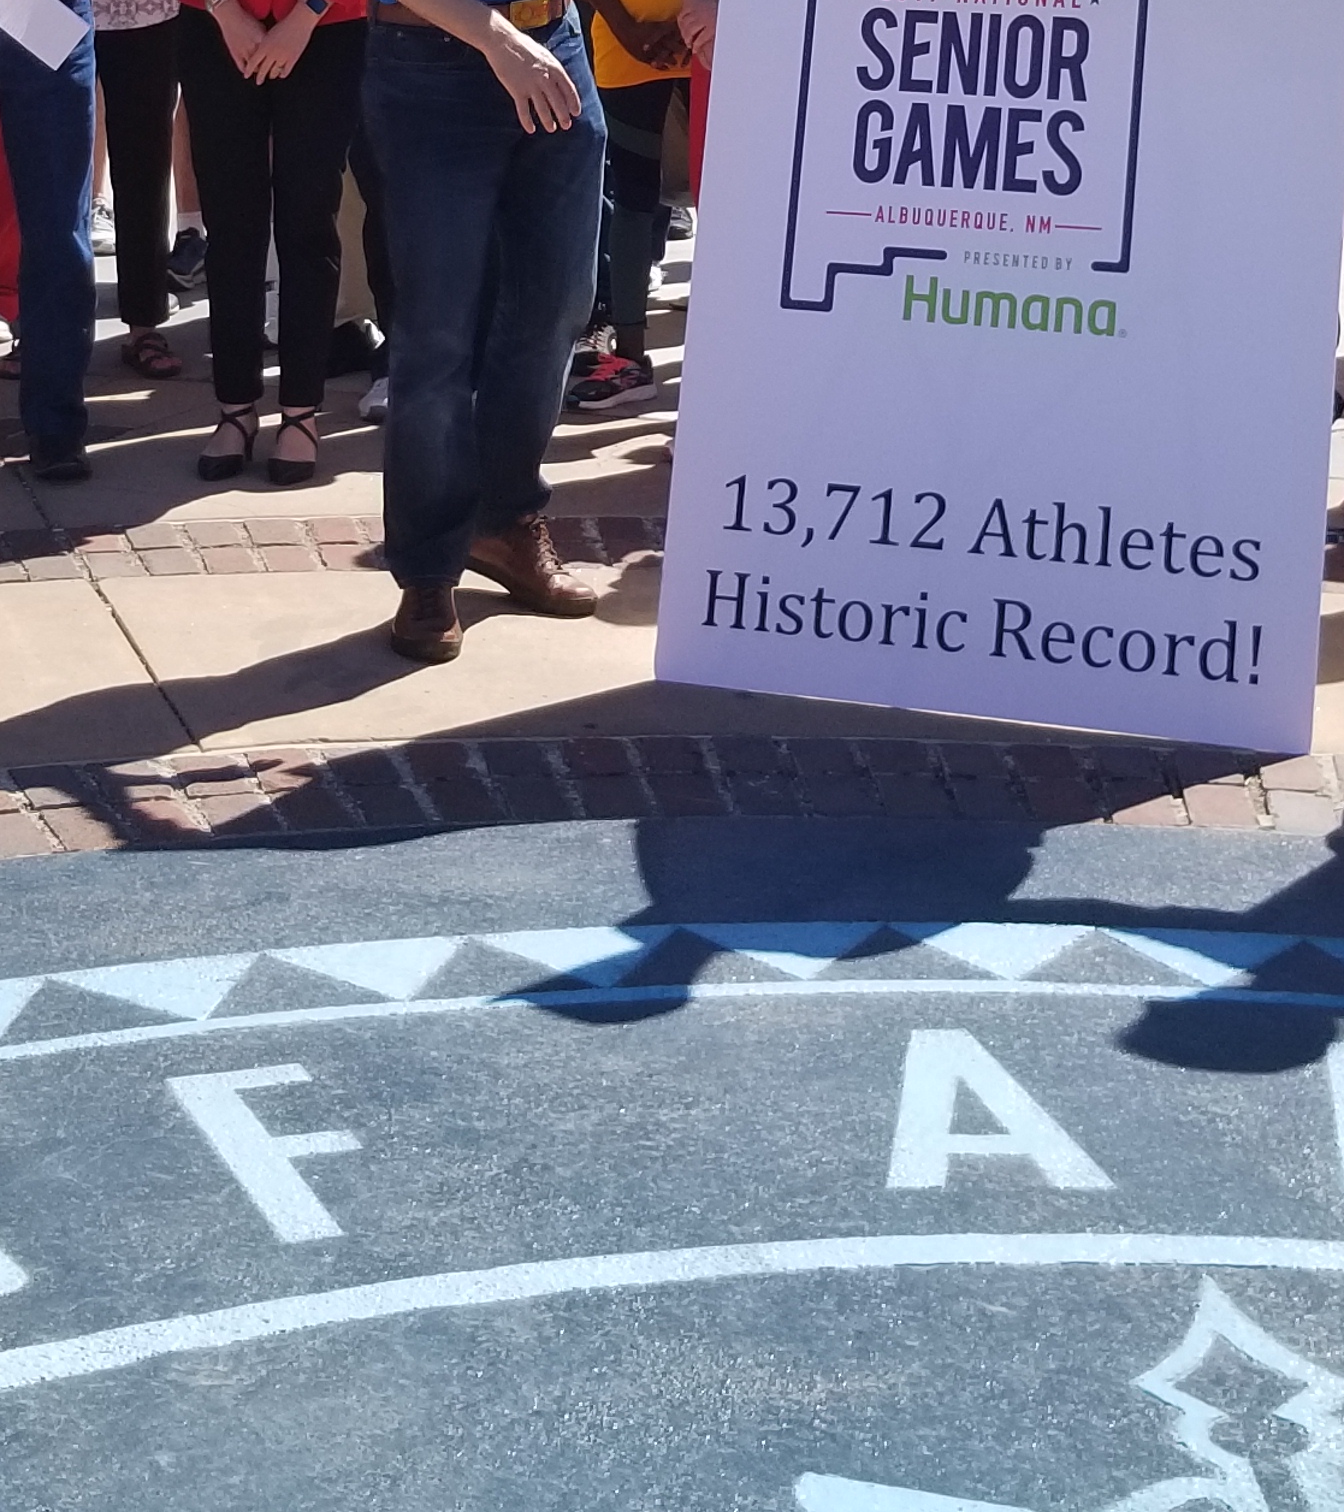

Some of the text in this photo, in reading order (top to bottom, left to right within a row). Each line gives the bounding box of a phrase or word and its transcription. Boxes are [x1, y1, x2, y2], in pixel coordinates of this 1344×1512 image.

[856, 7, 1089, 102] SENIOR
[853, 99, 1086, 196] GAMES
[963, 250, 1073, 271] PRESENTED BY
[1025, 215, 1052, 234] NM
[902, 274, 1117, 338] Humana
[722, 474, 1262, 582] 13,712 Athletes
[701, 569, 1264, 686] Historic Record!
